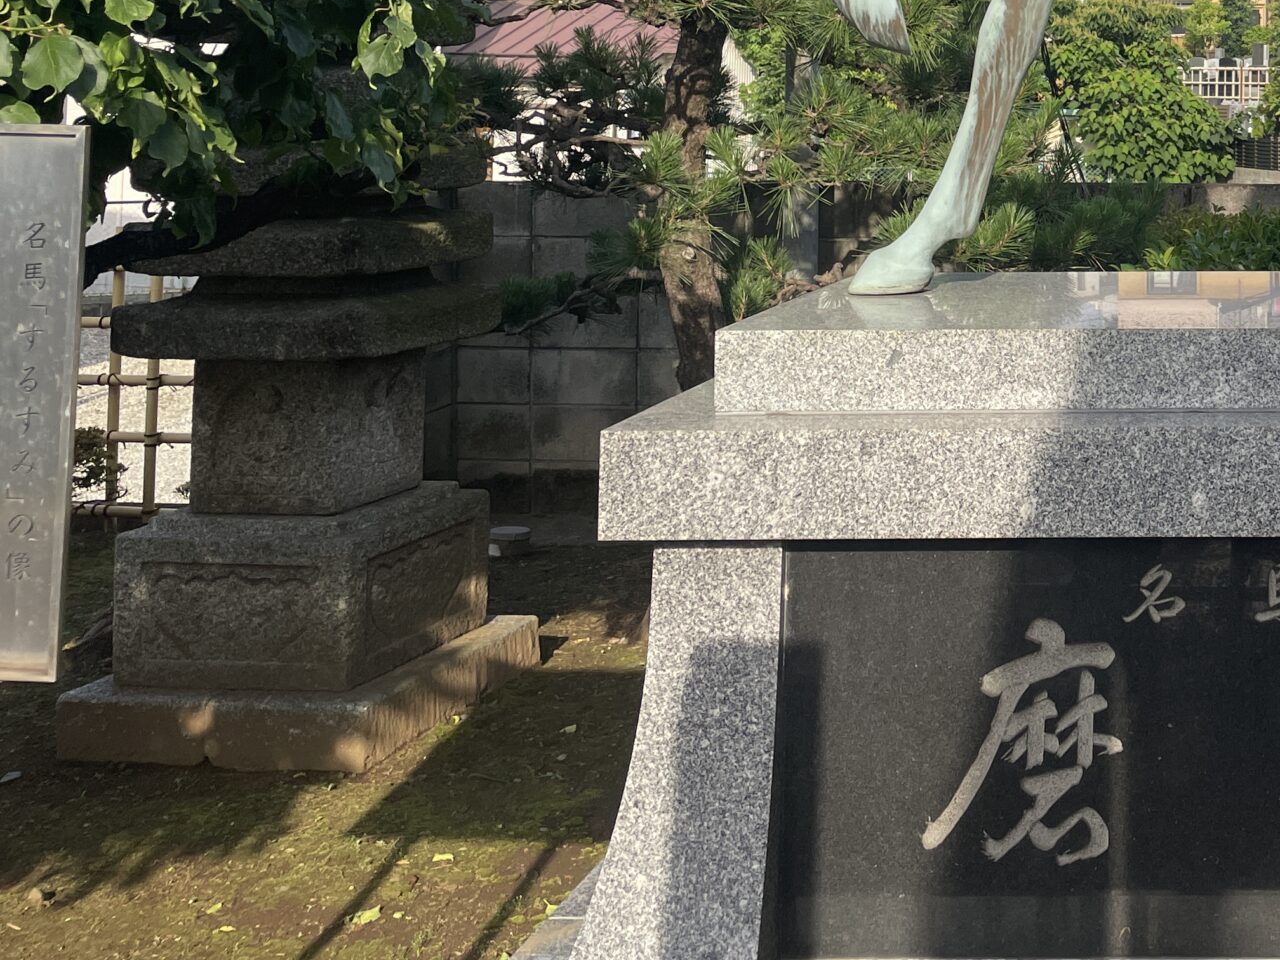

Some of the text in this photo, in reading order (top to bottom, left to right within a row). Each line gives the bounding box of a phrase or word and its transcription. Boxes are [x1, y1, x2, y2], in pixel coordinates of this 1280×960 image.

[4, 221, 49, 583] 名馬「するすみ」の像
